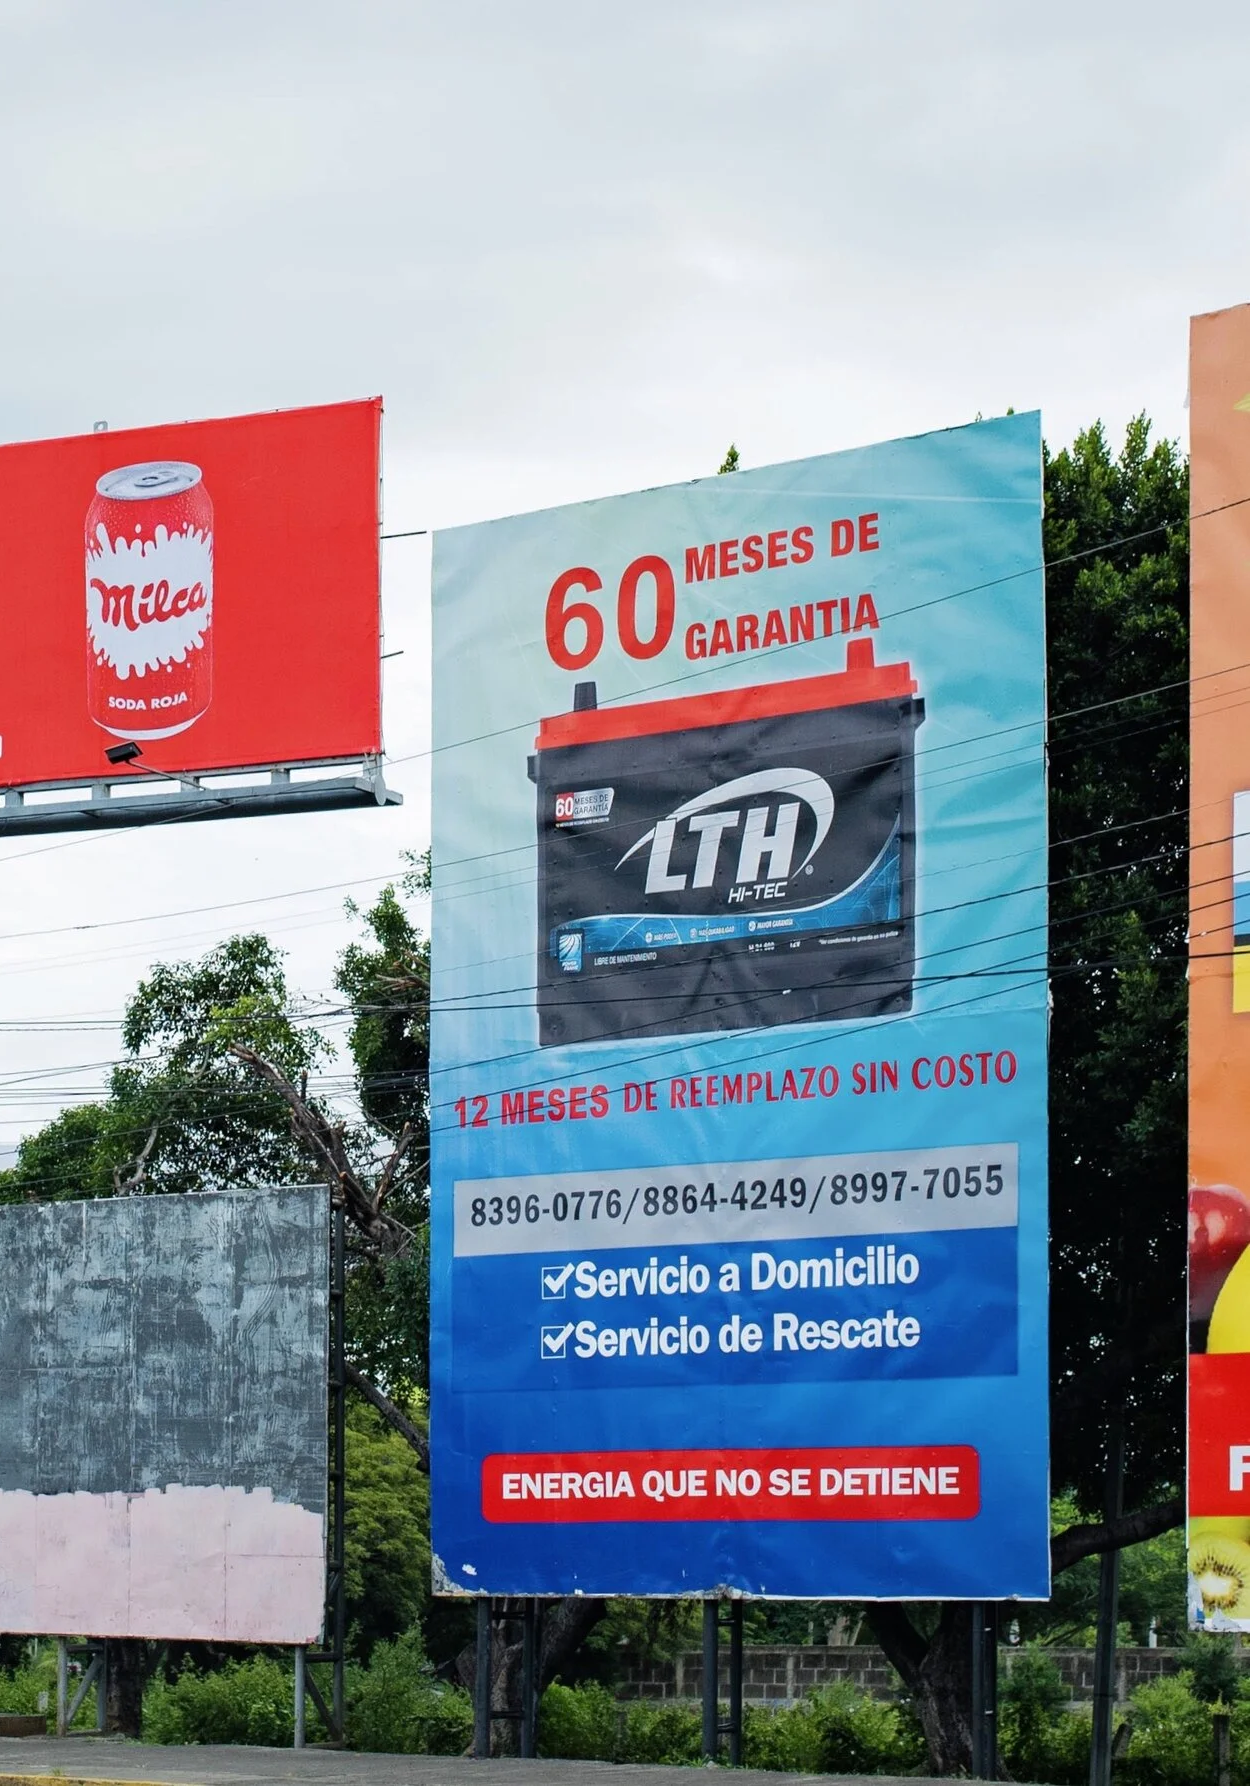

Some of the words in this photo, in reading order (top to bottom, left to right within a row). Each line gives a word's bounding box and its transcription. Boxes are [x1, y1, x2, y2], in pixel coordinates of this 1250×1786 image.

[90, 577, 207, 631] Milca
[544, 553, 676, 670] 60
[685, 526, 814, 583] MESES
[831, 512, 880, 559] DE
[685, 594, 880, 660] GARANTIA
[108, 695, 146, 711] SODA
[151, 691, 188, 709] ROJA
[555, 796, 574, 818] 60
[575, 795, 597, 805] MESES
[645, 802, 800, 895] LTH
[727, 881, 788, 904] HI-TEC
[455, 1095, 488, 1128] 12
[501, 1085, 610, 1126] MESES
[623, 1081, 657, 1113] DE
[669, 1065, 840, 1109] REEMPLAZO
[852, 1060, 899, 1095] SIN
[911, 1050, 1018, 1090] COSTO
[574, 1256, 710, 1299] Servicio
[719, 1265, 740, 1292] a
[752, 1244, 919, 1290] Domicilio
[574, 1315, 710, 1358] Servicio
[718, 1314, 763, 1353] de
[773, 1309, 920, 1352] Rescate
[501, 1471, 636, 1499] ENERGIA
[642, 1469, 707, 1501] QUE
[715, 1468, 762, 1496] NO
[768, 1467, 811, 1496] SE
[820, 1466, 959, 1496] DETIENE
